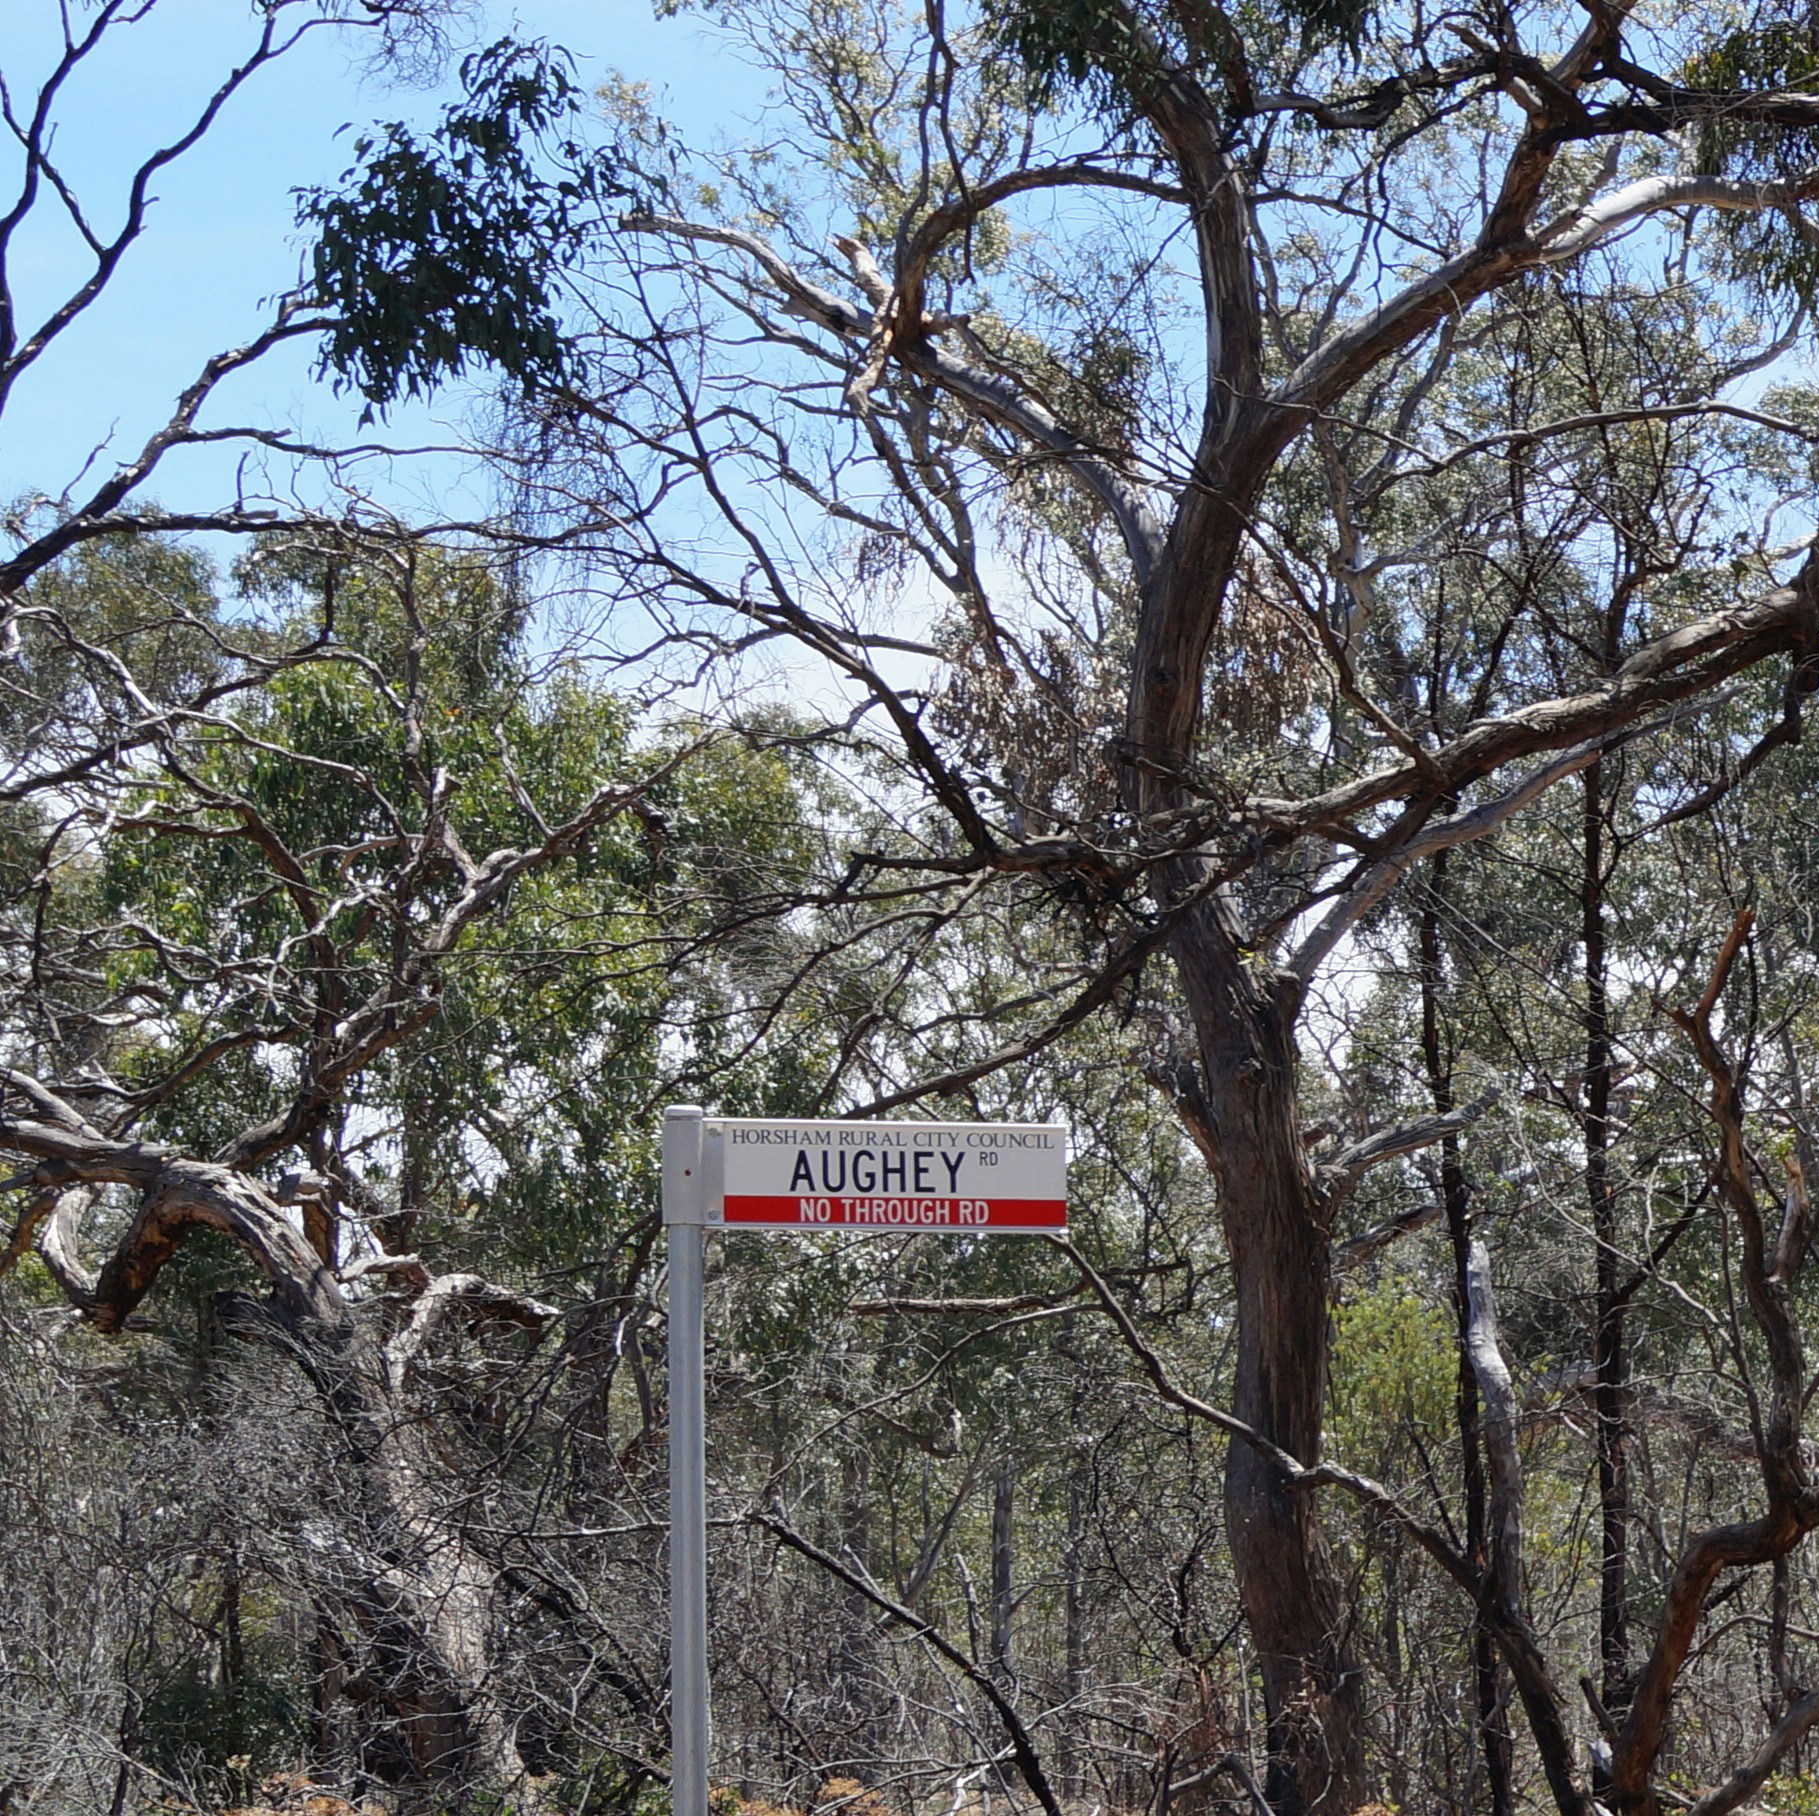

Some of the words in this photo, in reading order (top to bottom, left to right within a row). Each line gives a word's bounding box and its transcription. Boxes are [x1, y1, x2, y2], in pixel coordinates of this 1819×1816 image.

[732, 1128, 832, 1146] HORSHAM
[838, 1130, 908, 1147] RURAL
[913, 1131, 960, 1148] CITY
[966, 1132, 1055, 1150] COUNCIL
[789, 1149, 966, 1194] AUGHEY
[979, 1151, 999, 1167] RD
[800, 1198, 832, 1223] NO
[840, 1199, 950, 1225] THROUGH
[958, 1200, 990, 1225] RD
